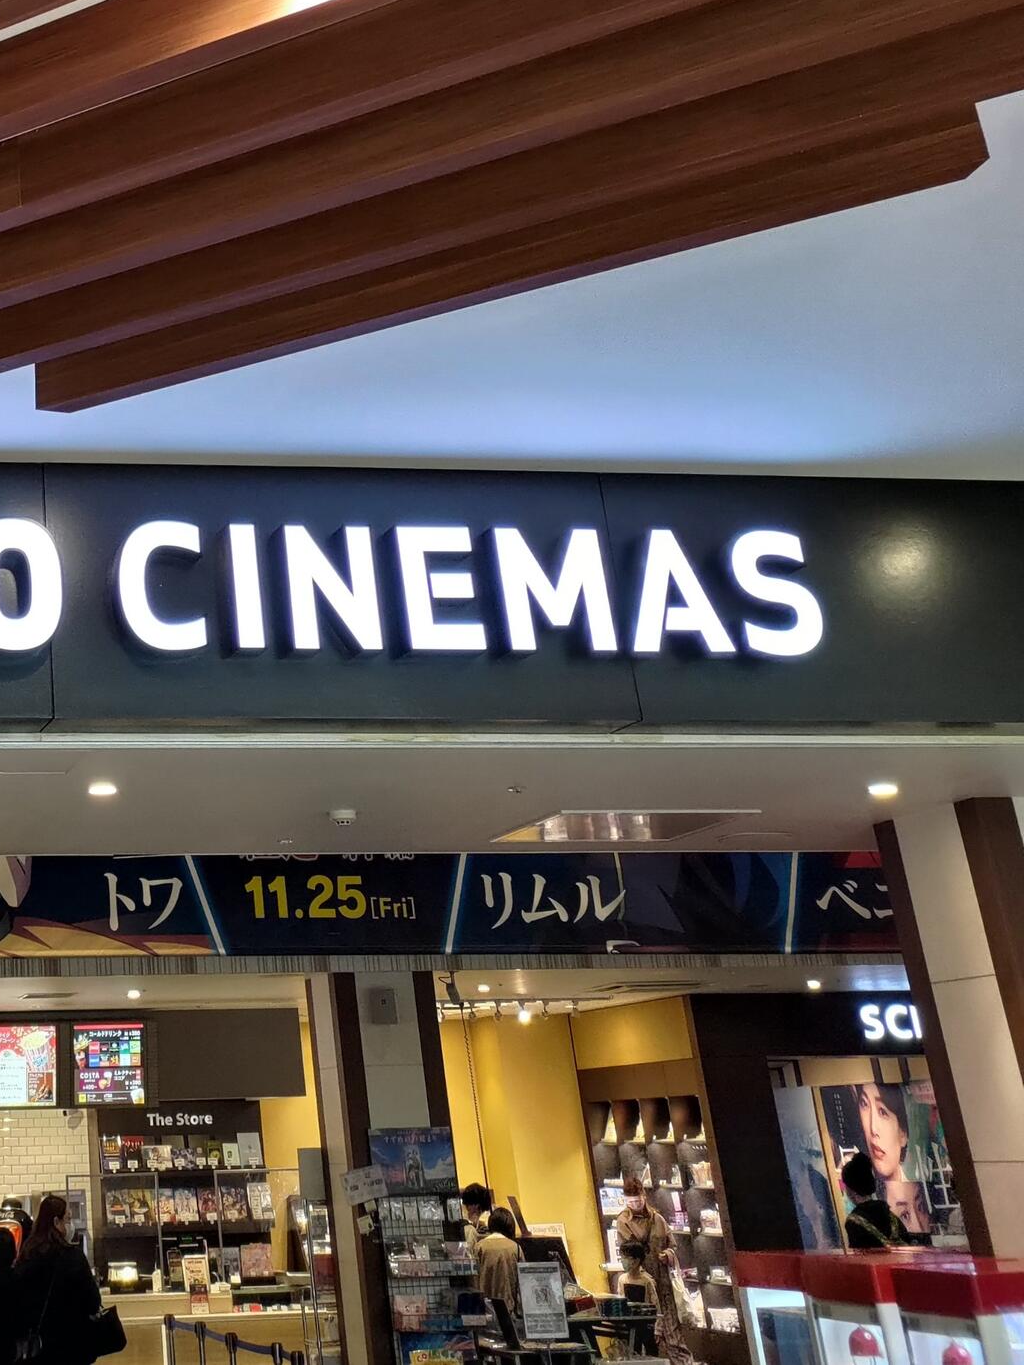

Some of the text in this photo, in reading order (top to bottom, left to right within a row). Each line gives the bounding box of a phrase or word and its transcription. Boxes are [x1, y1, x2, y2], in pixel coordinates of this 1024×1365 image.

[116, 520, 824, 657] CINEMAS
[104, 872, 183, 931] トワ
[244, 874, 367, 919] 11.25
[480, 872, 626, 930] リムル
[147, 1113, 213, 1126] The Store
